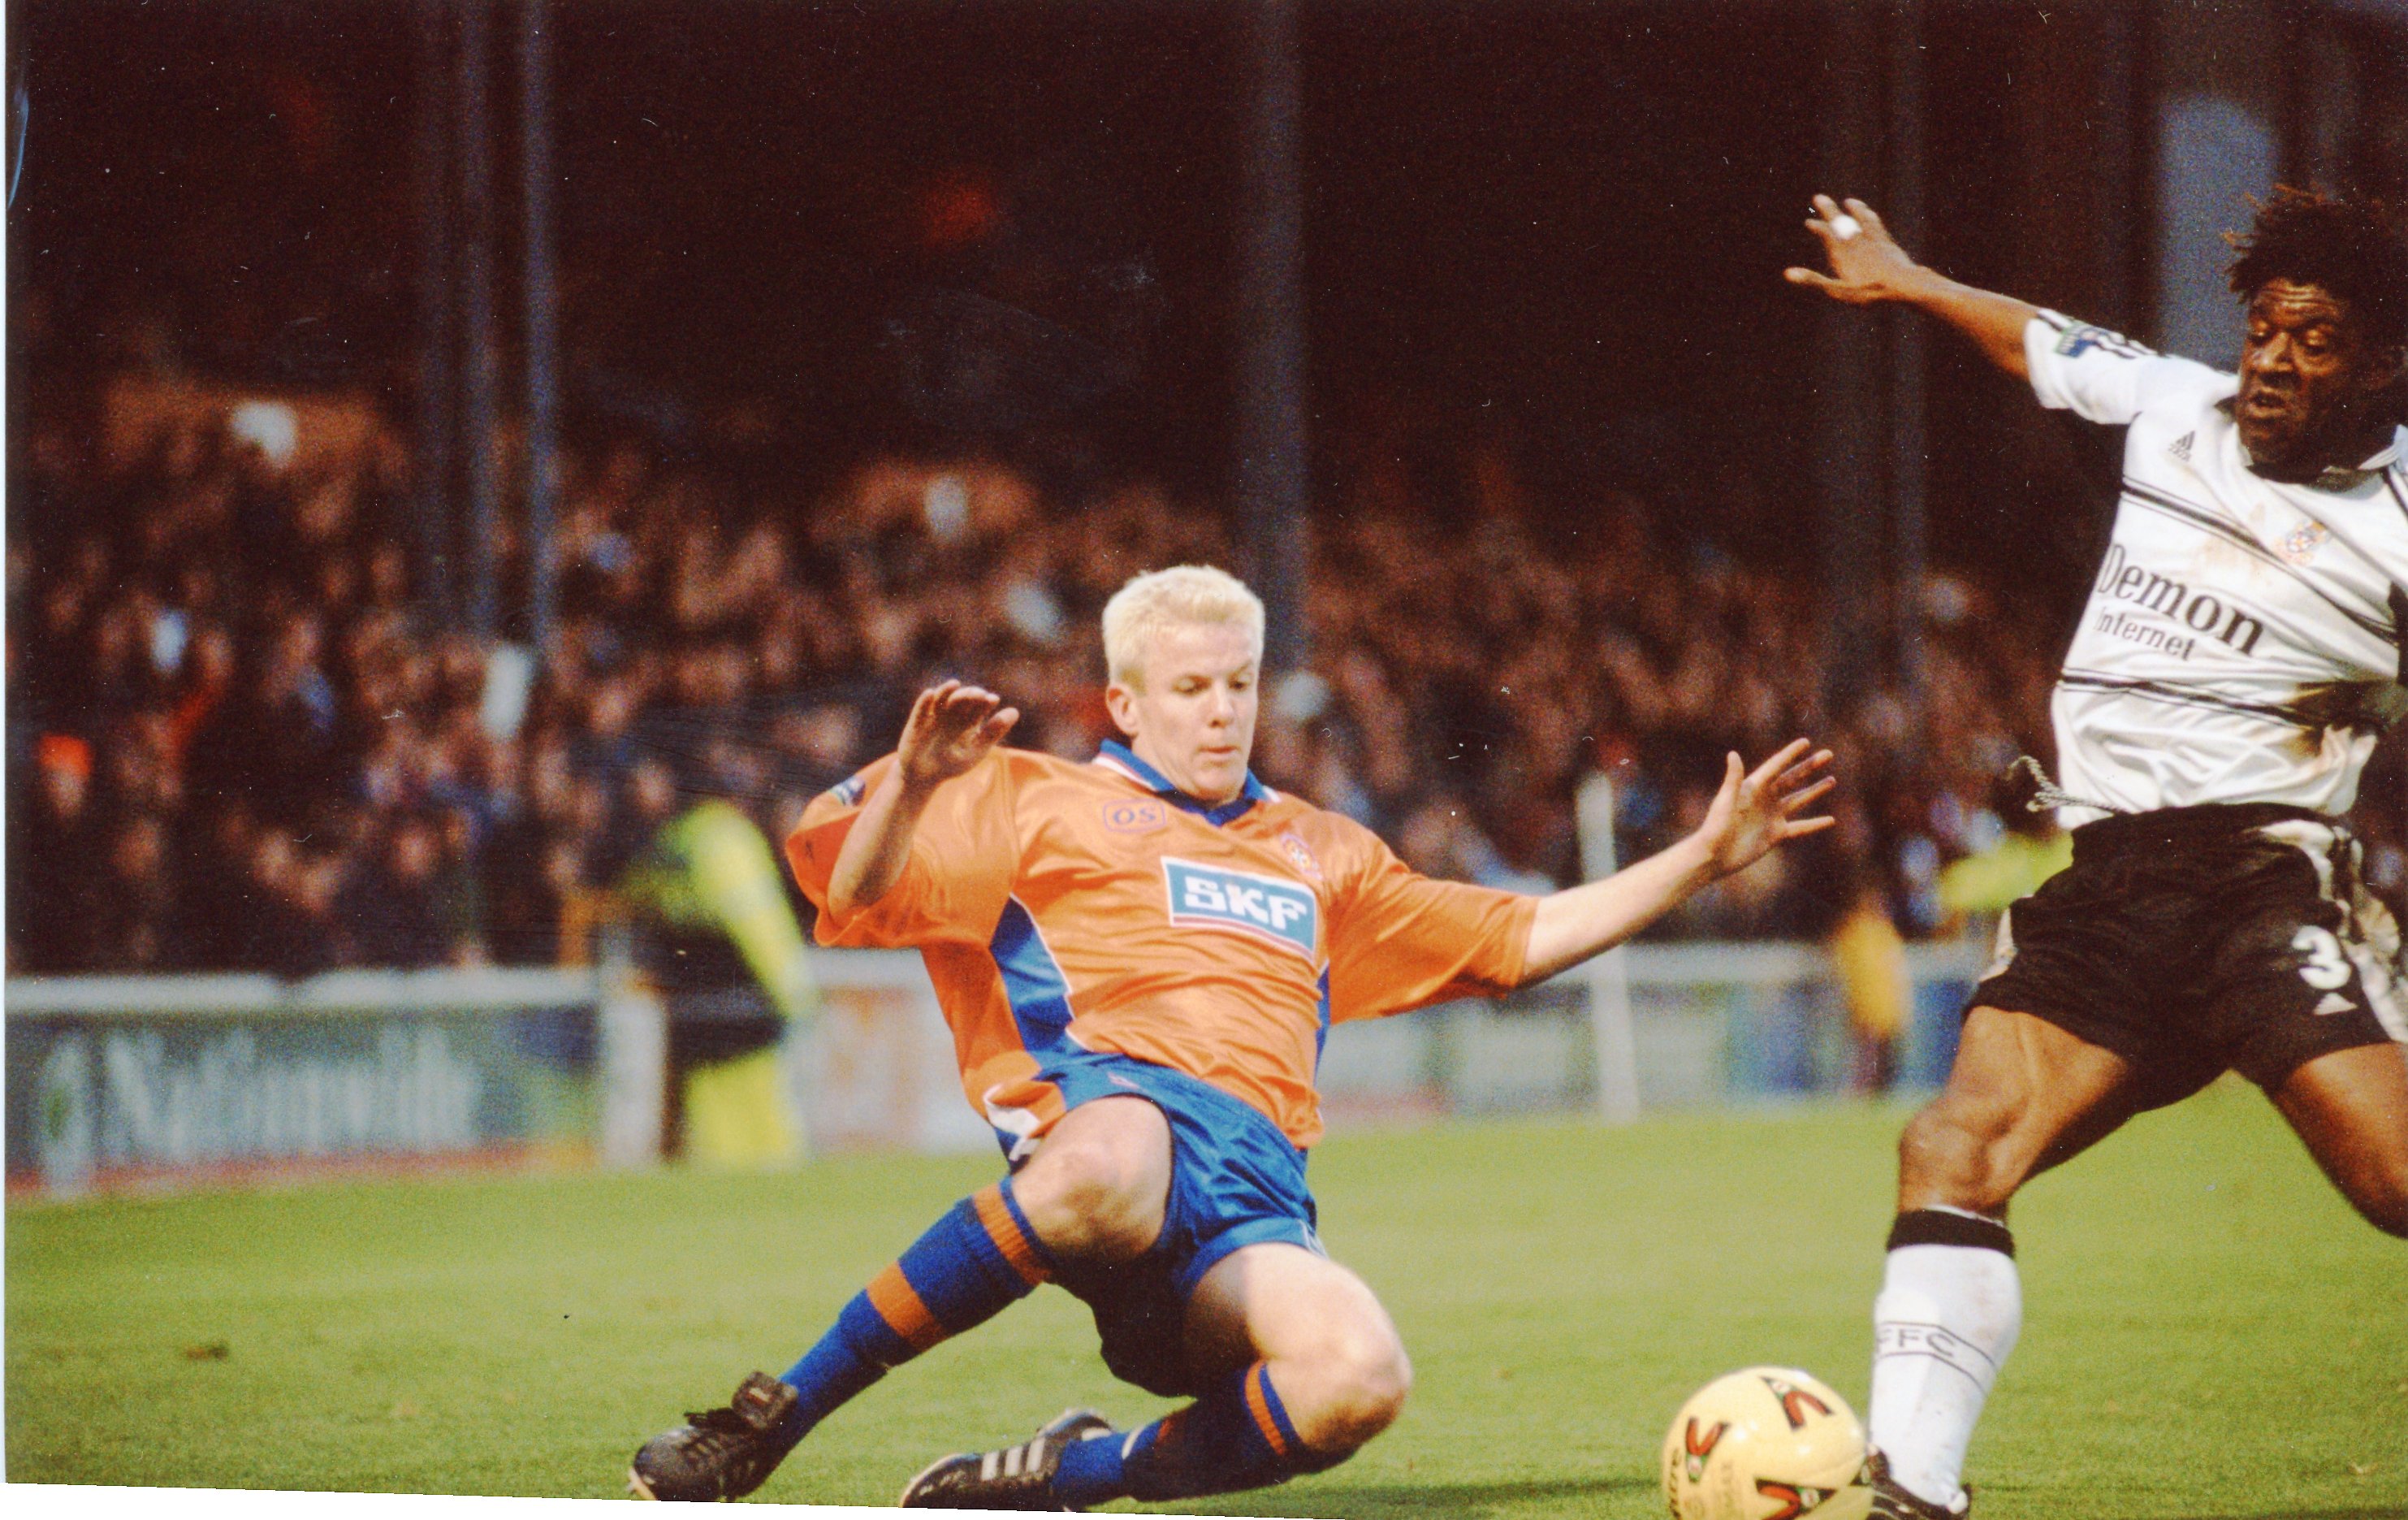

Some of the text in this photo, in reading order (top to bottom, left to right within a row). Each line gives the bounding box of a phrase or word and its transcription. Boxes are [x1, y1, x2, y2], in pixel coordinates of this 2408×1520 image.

[2098, 543, 2264, 657] Demon
[1112, 806, 1156, 825] OS
[1184, 876, 1308, 930] SKF
[2291, 924, 2352, 990] 3
